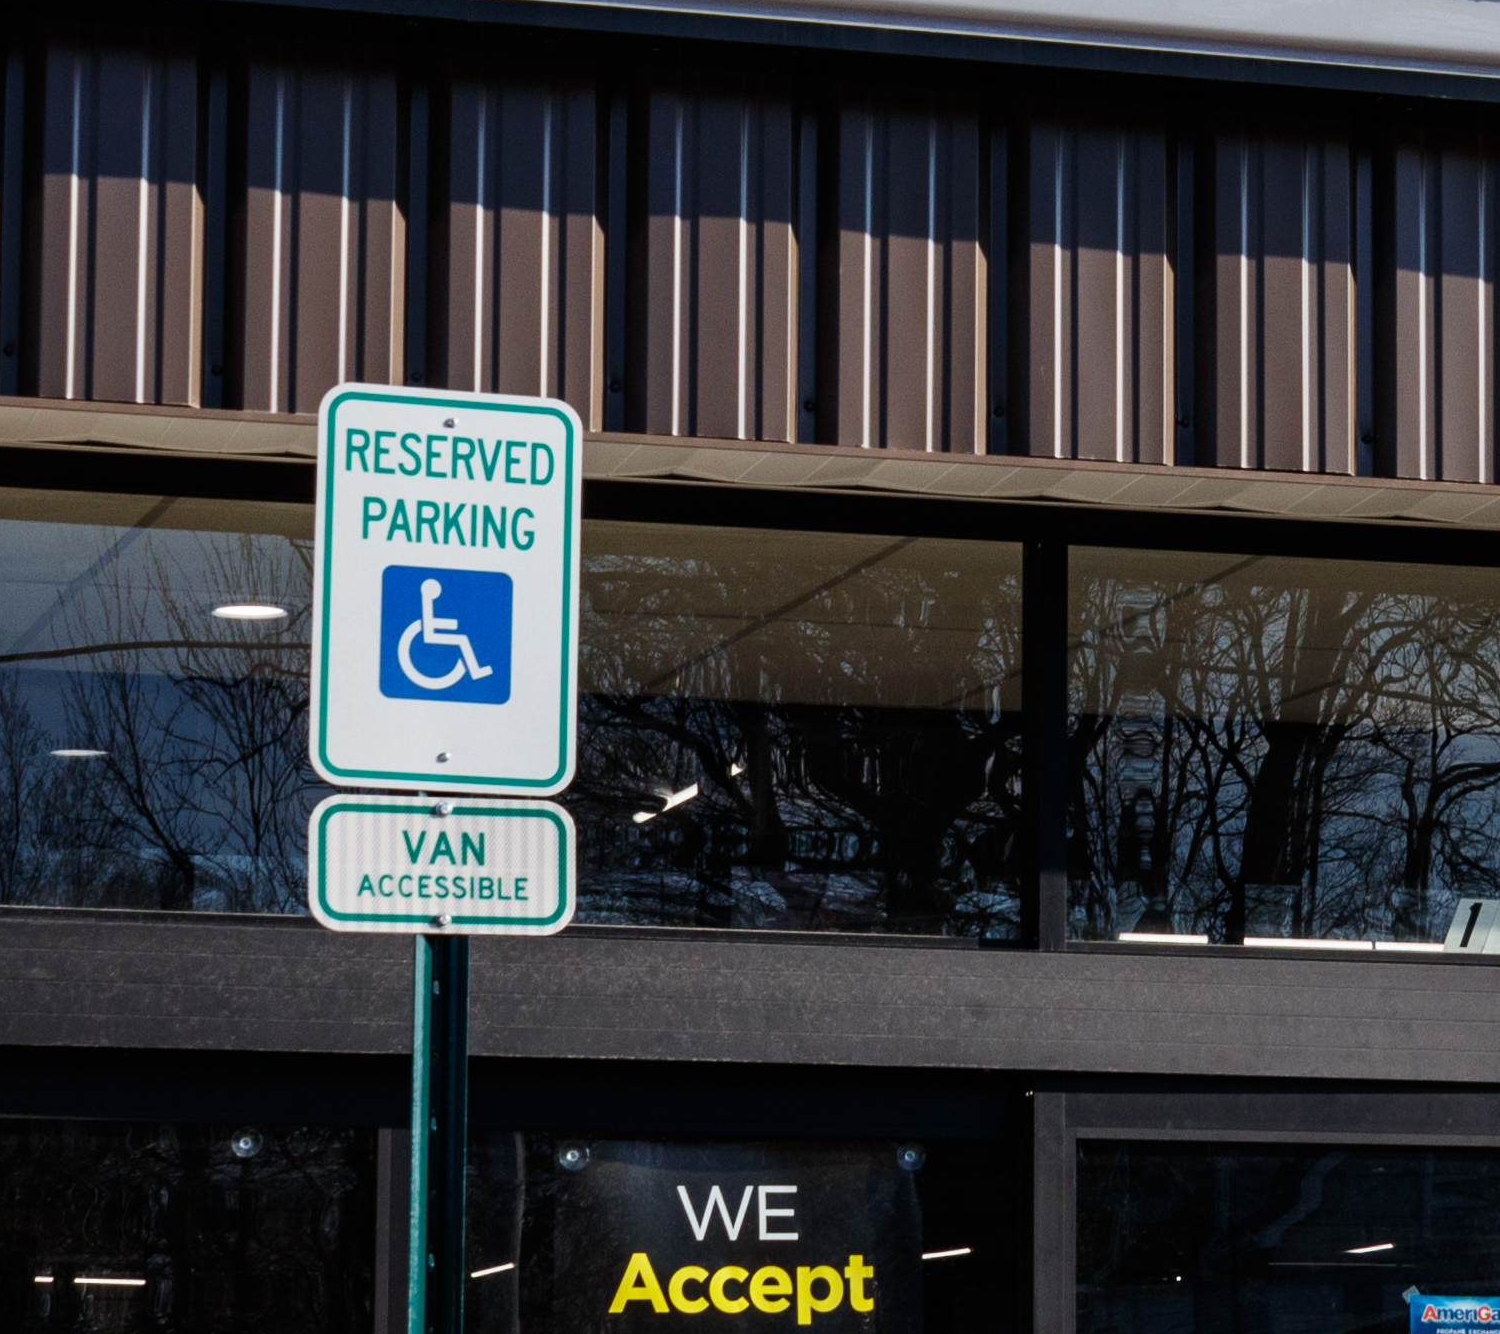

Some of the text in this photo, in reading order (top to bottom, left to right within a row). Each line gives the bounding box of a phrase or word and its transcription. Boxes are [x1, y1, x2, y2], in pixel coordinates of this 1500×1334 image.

[345, 428, 555, 486] RESERVED
[361, 496, 536, 551] PARKING
[402, 830, 485, 867] VAN
[357, 874, 529, 902] ACCESSIBLE
[676, 1185, 798, 1241] WE
[608, 1252, 875, 1325] Accept
